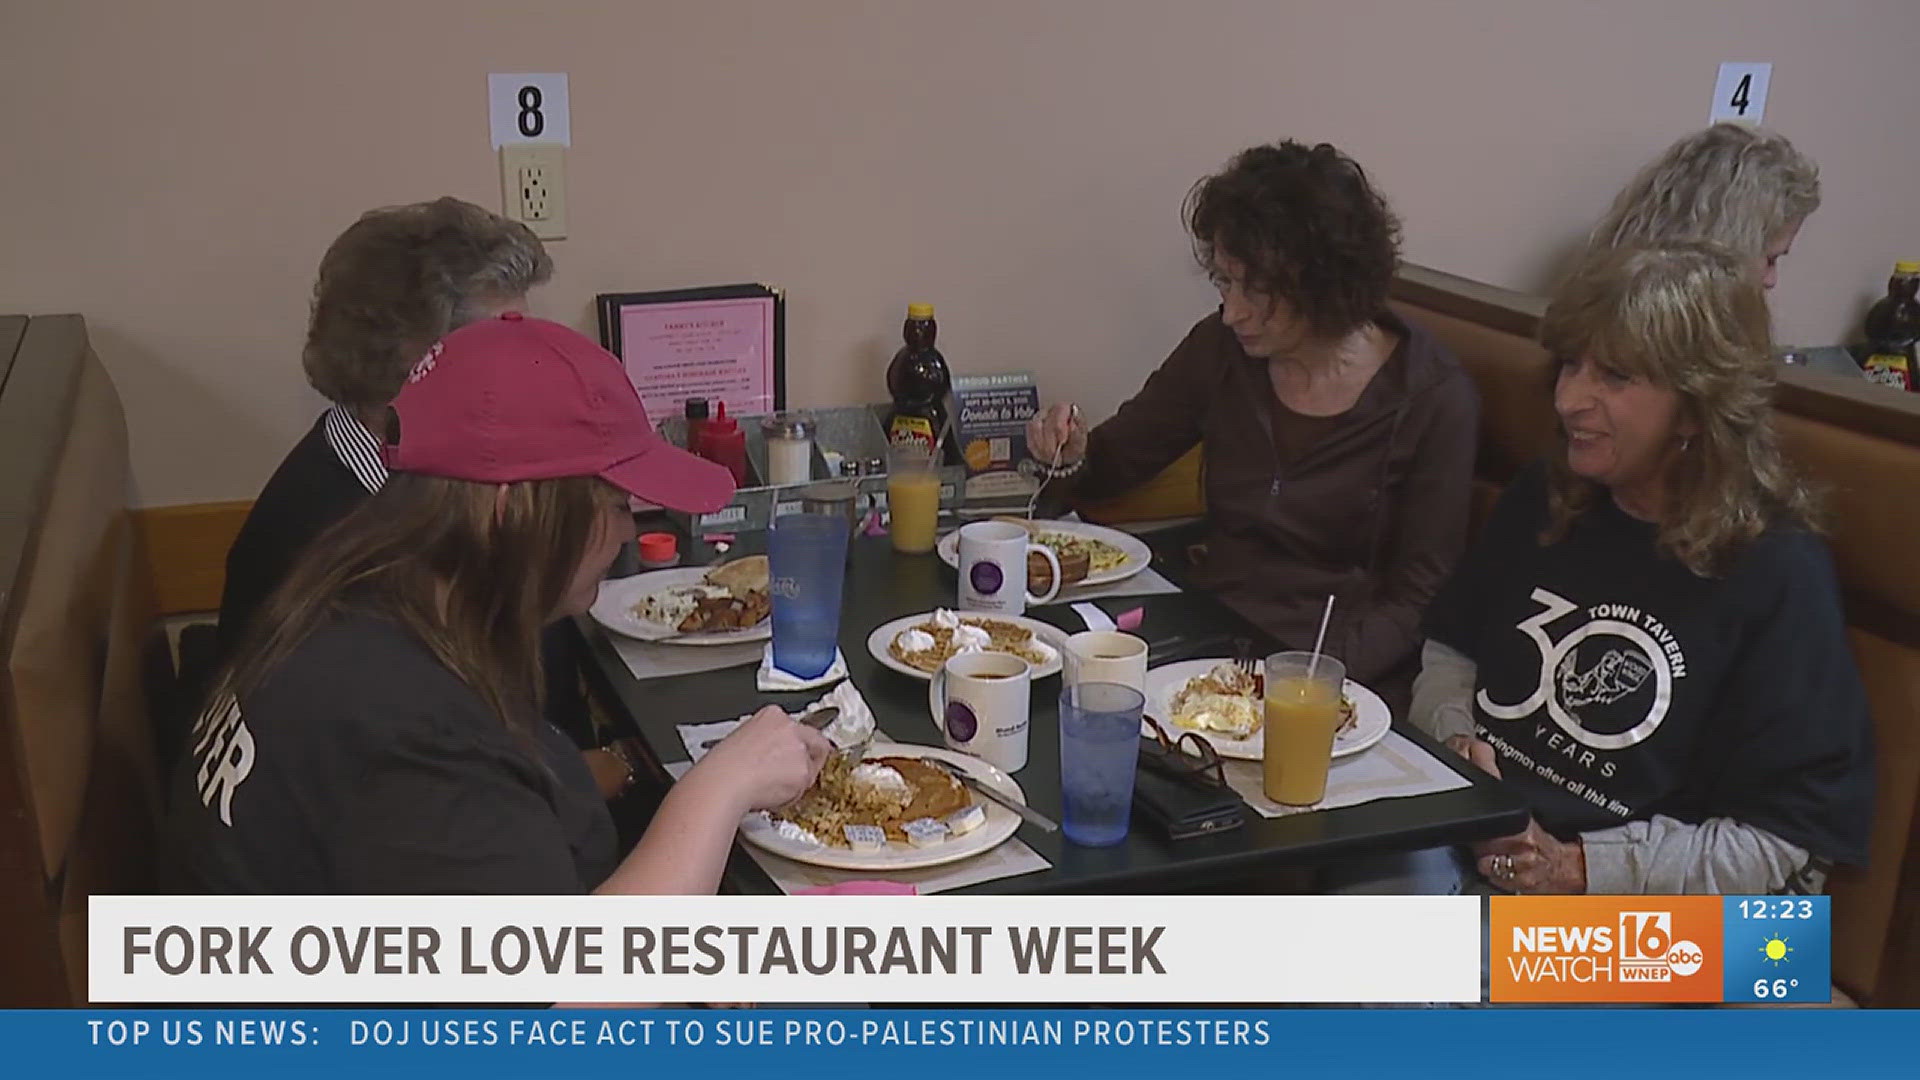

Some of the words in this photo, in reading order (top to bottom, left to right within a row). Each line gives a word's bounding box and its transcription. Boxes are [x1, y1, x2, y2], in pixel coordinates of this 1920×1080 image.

[517, 86, 544, 137] 8
[1730, 74, 1752, 116] 4
[991, 374, 1028, 384] PARTNER
[960, 407, 999, 422] Donate
[1001, 406, 1011, 420] to
[1588, 604, 1641, 623] TOWN
[1643, 614, 1687, 679] TAVERN
[1476, 586, 1672, 750] 30
[1534, 724, 1617, 778] YEARS
[1536, 765, 1566, 787] after
[1566, 780, 1587, 796] all
[1583, 787, 1608, 808] this
